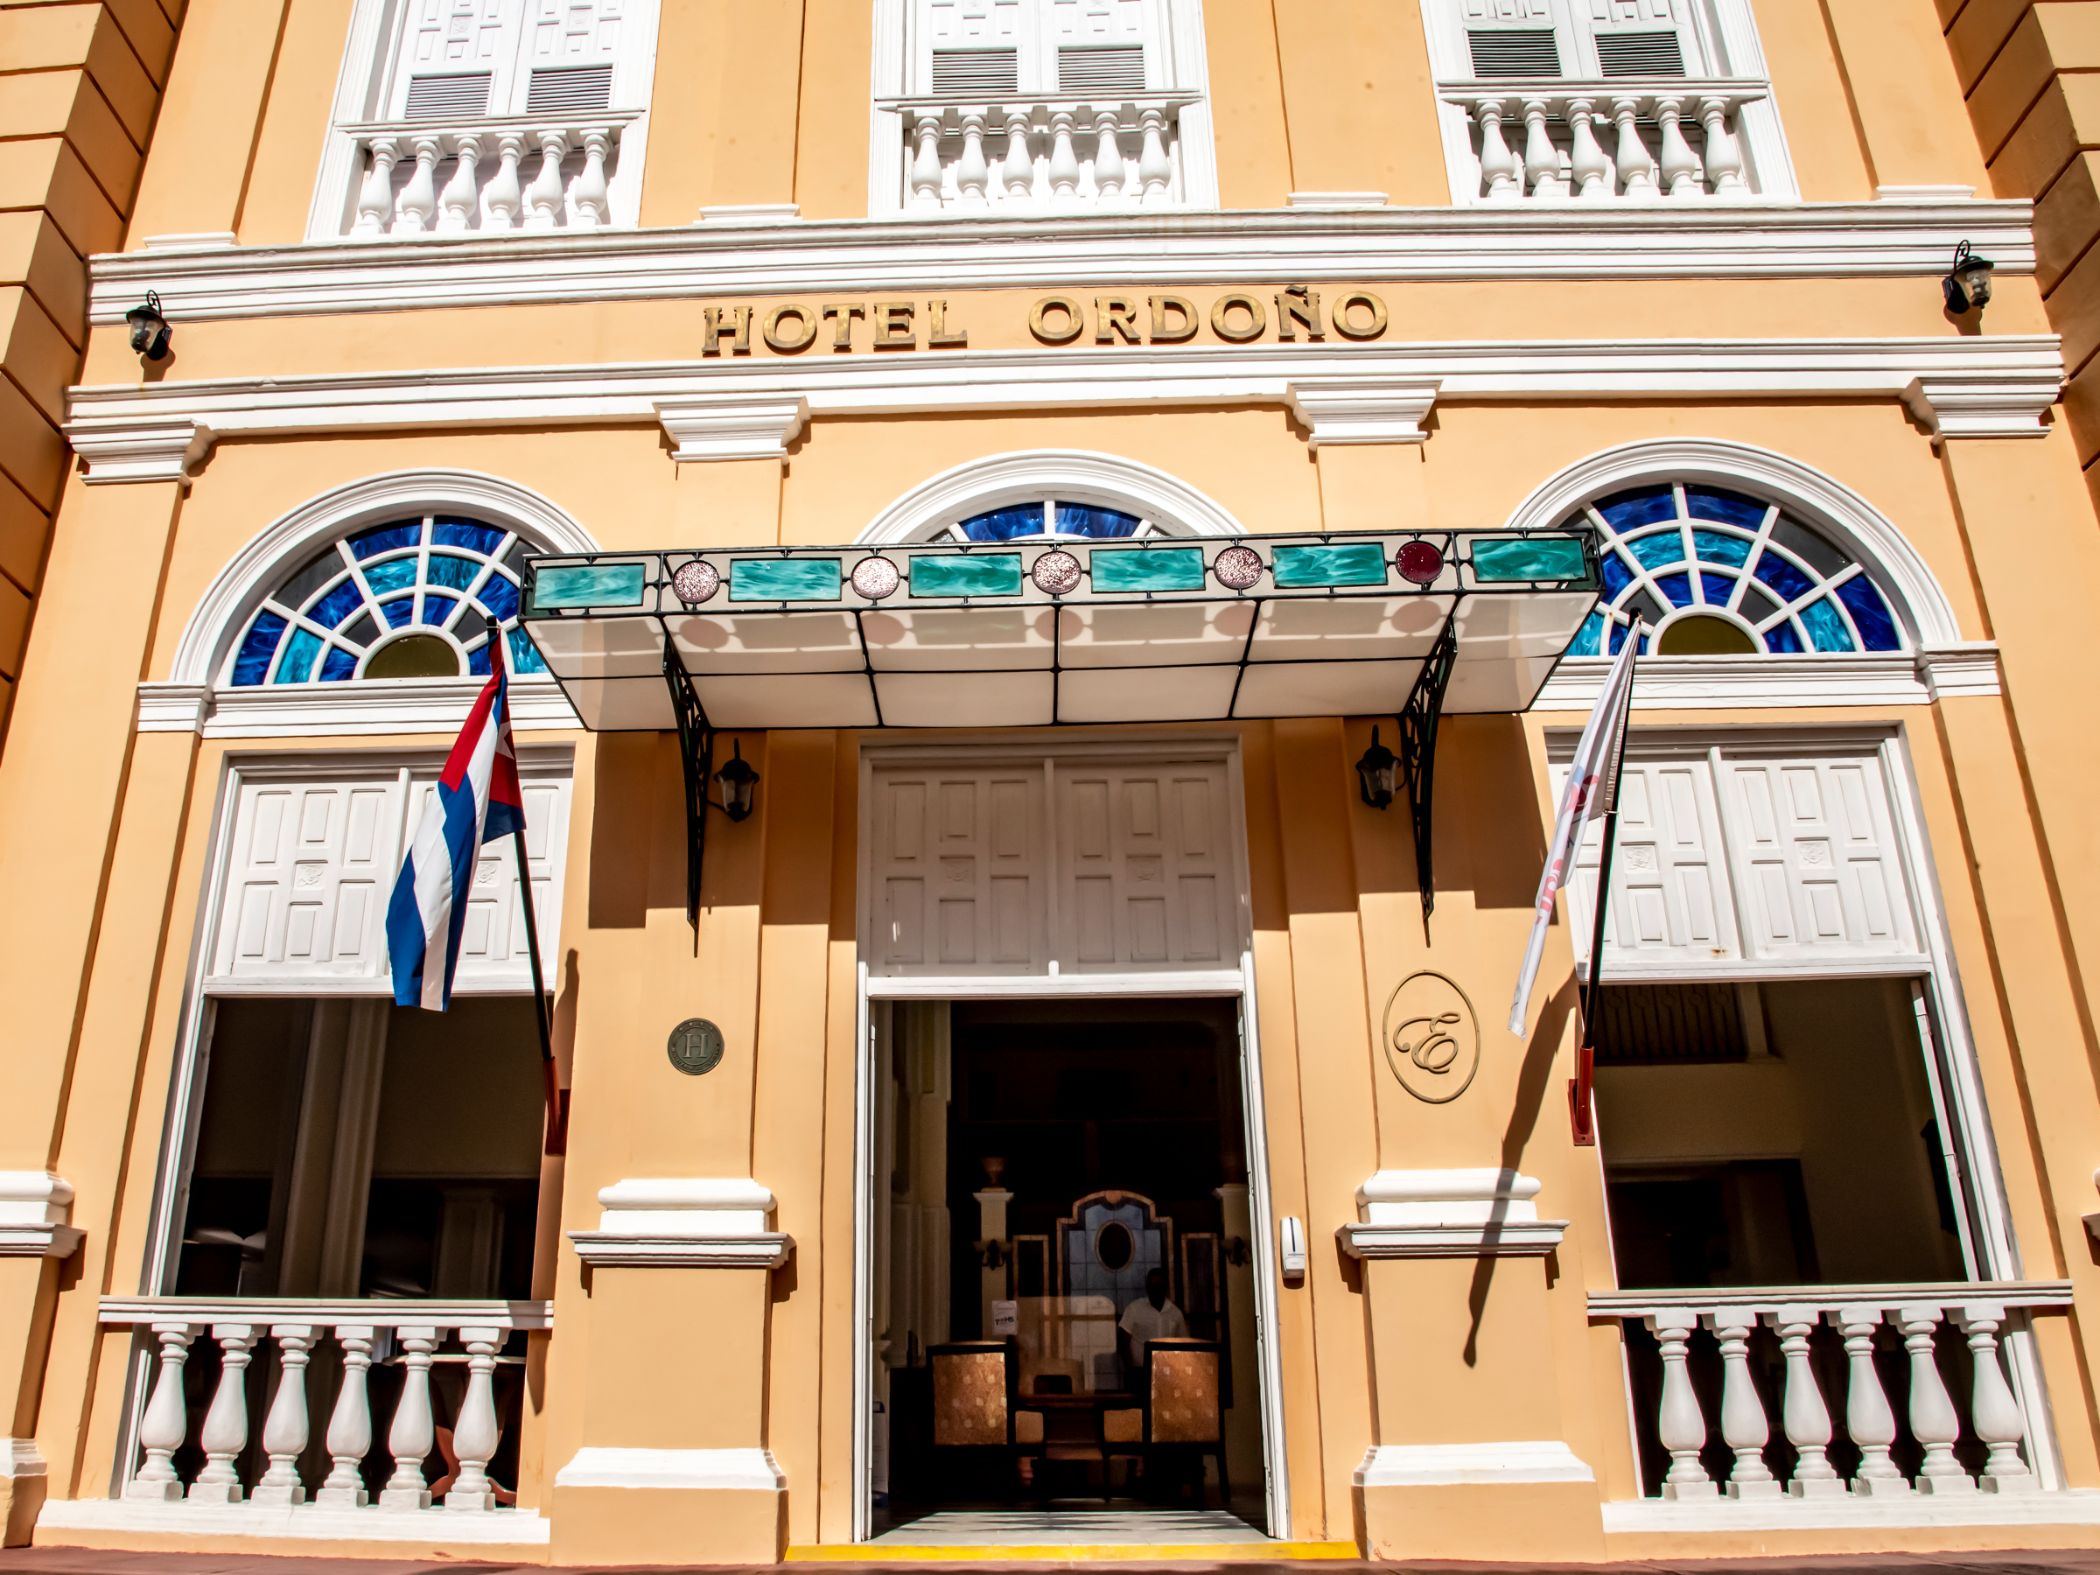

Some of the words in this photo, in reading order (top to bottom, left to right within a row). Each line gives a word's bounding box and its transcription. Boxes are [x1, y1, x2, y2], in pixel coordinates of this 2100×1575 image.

[702, 300, 967, 354] HOTEL
[1029, 285, 1388, 344] ORDOÑO
[681, 1033, 709, 1058] H
